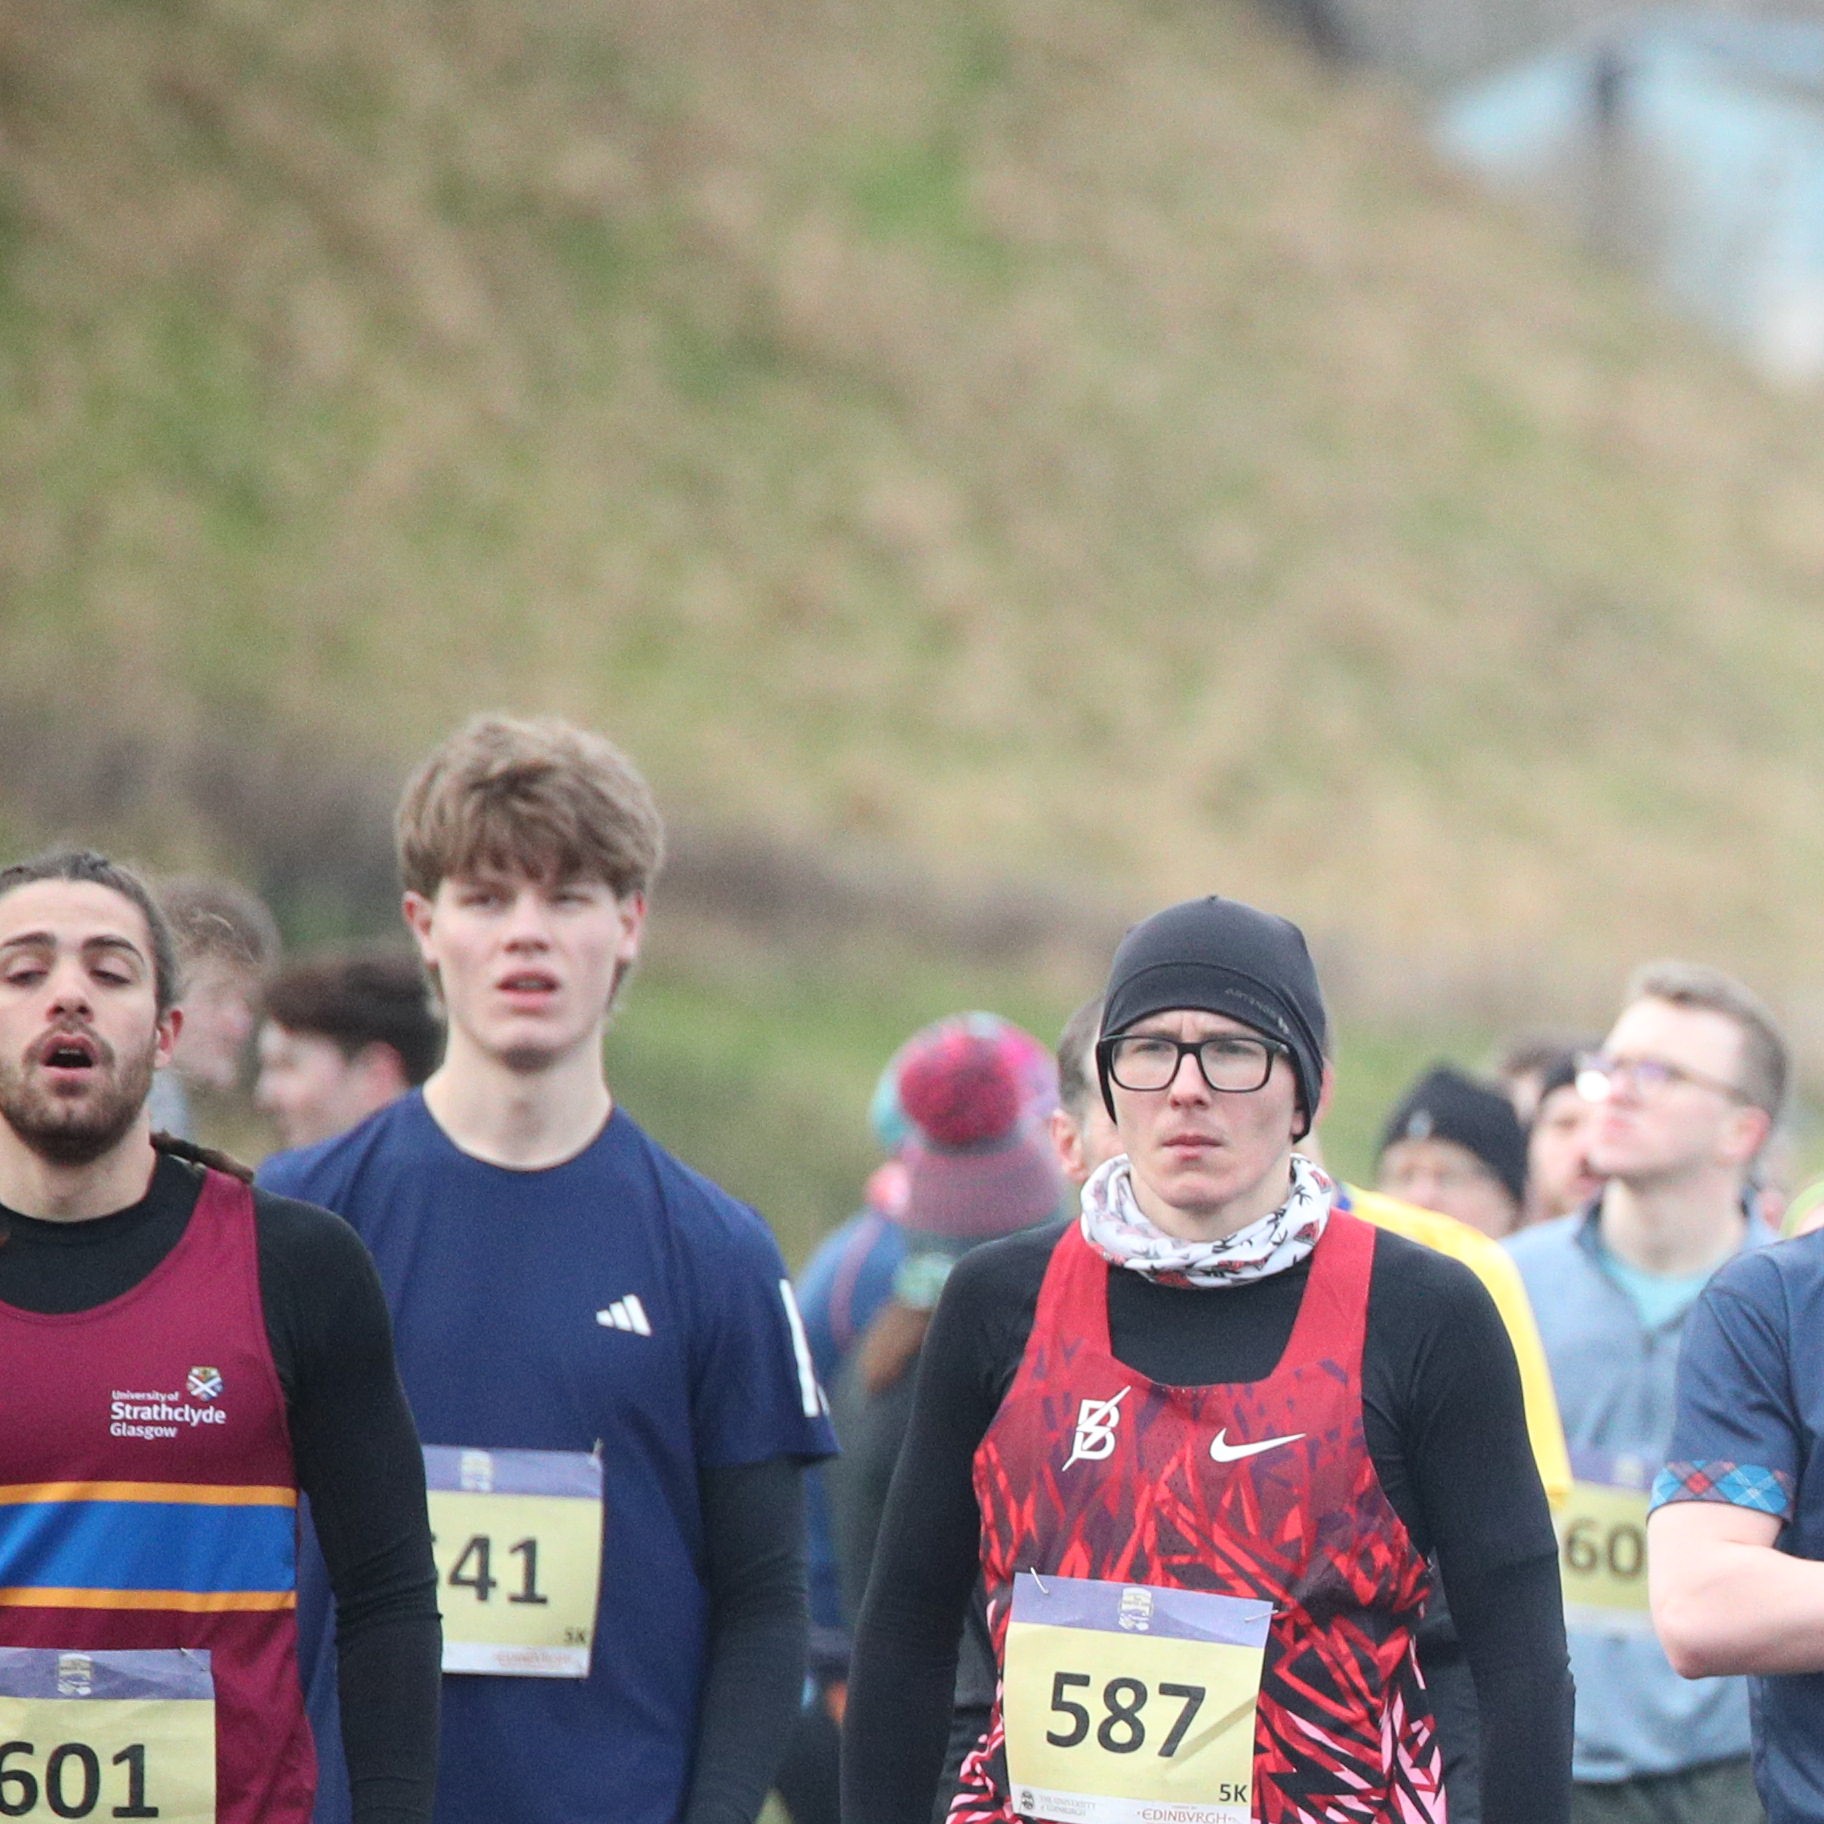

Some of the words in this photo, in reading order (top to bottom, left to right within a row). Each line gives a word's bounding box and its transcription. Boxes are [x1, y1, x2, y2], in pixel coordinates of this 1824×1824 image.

[112, 1389, 165, 1402] University
[167, 1391, 179, 1401] of
[111, 1402, 226, 1427] Strathclyde
[110, 1423, 177, 1440] Glasgow
[430, 1533, 549, 1605] 41
[1045, 1671, 1206, 1758] 587
[0, 1741, 159, 1819] 601
[1218, 1783, 1247, 1803] 5K
